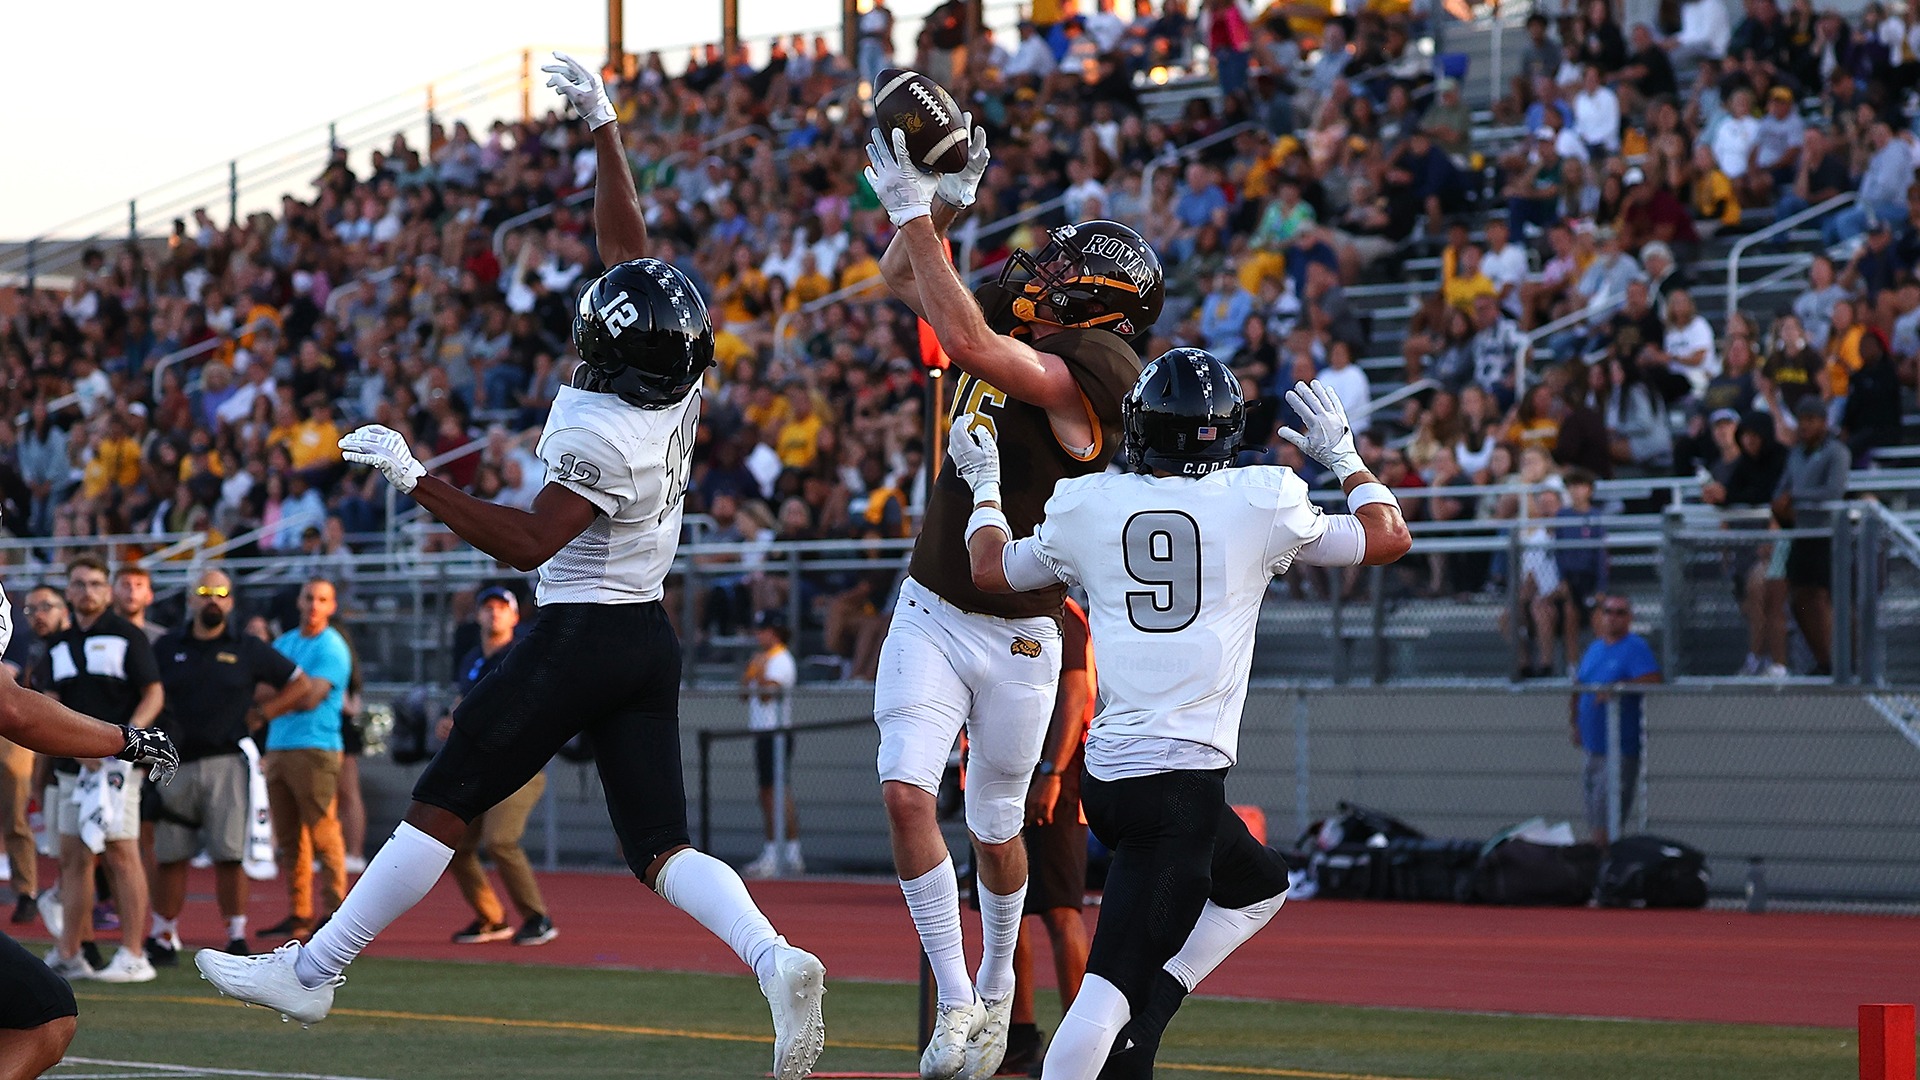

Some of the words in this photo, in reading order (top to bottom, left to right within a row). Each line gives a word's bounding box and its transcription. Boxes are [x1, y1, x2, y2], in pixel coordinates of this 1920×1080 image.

[1082, 234, 1155, 299] ROWAN
[598, 291, 639, 339] 12
[559, 453, 601, 487] 12
[1121, 509, 1202, 634] 9
